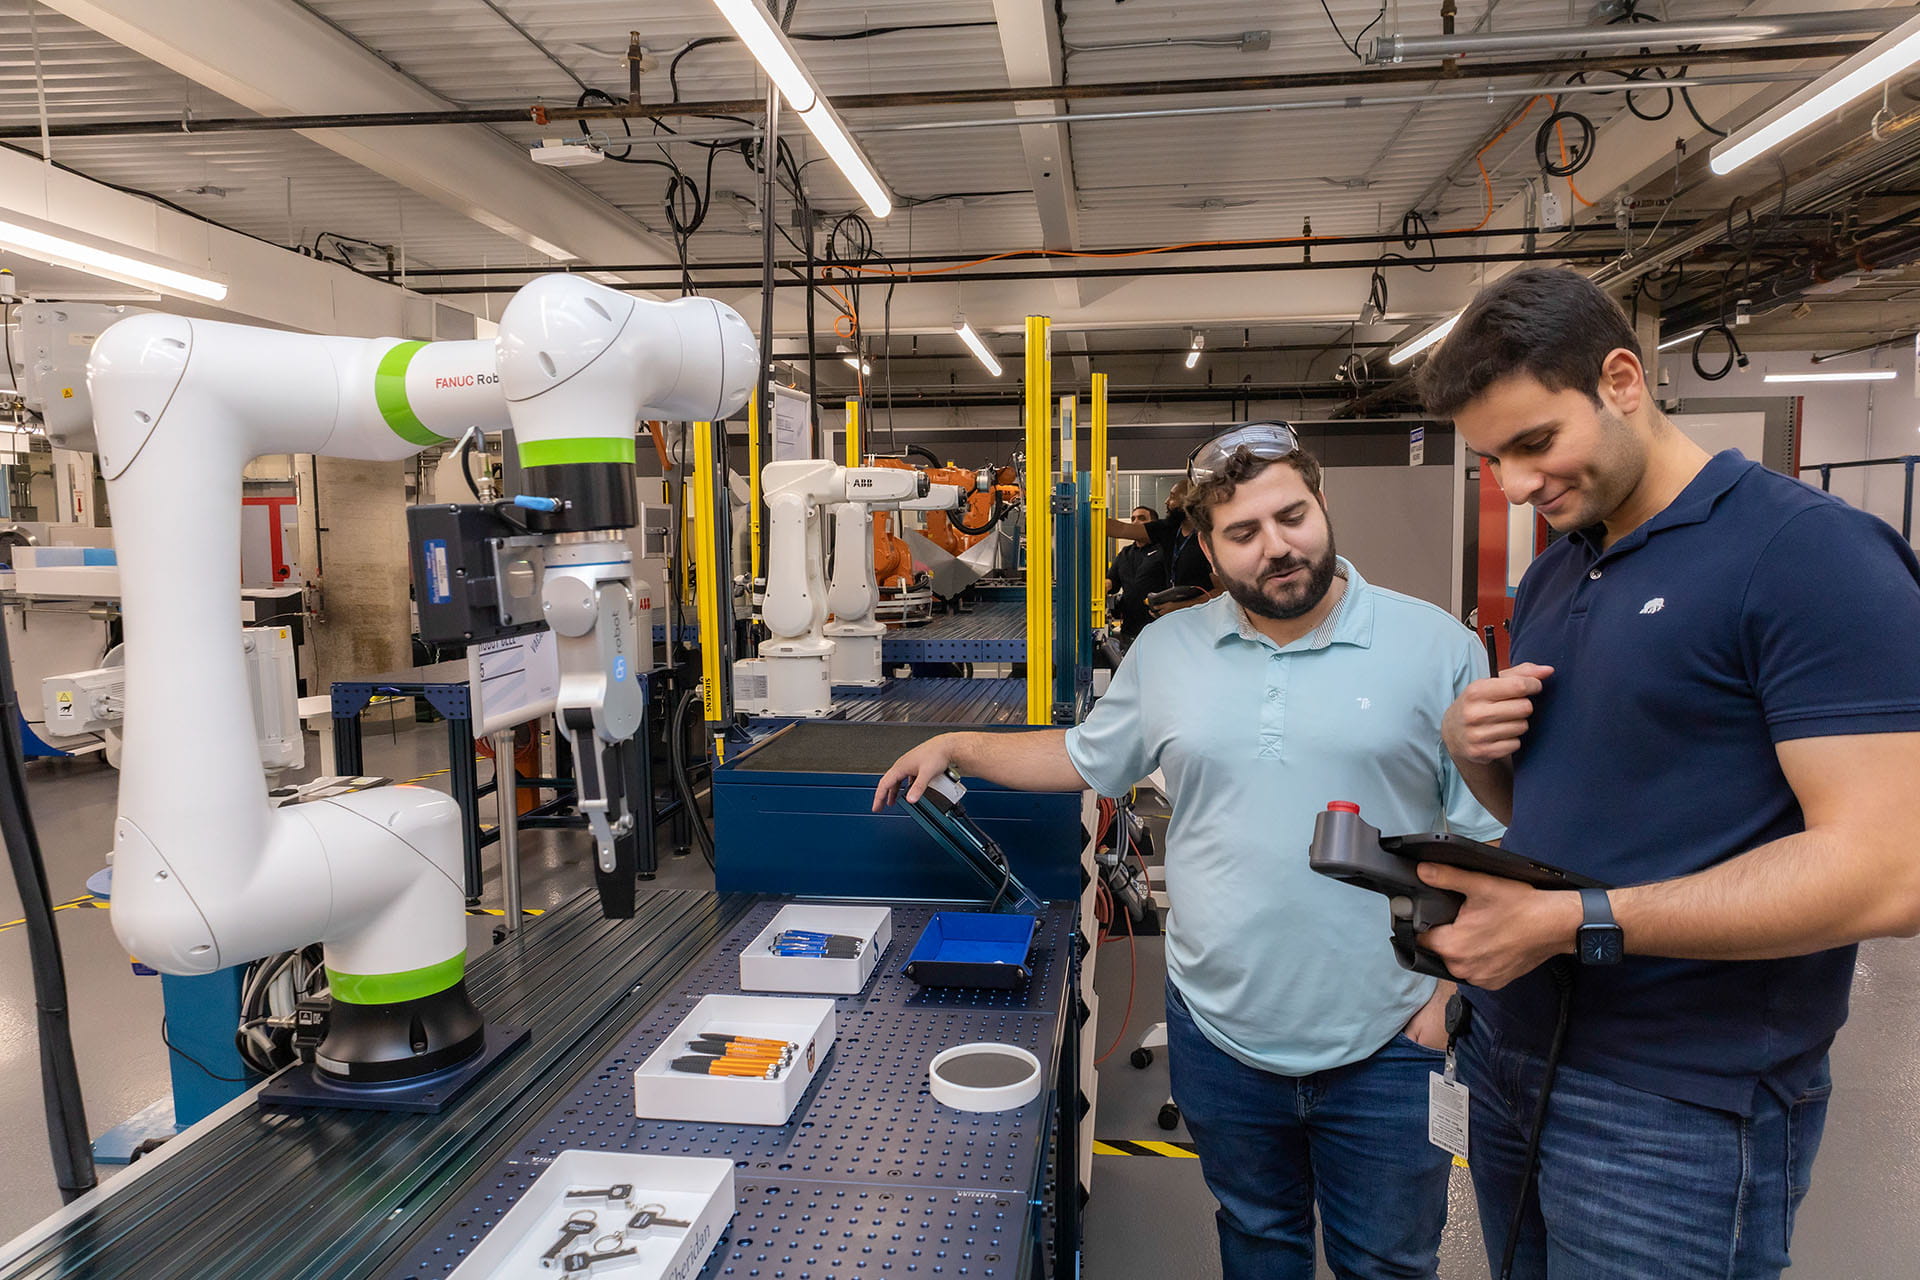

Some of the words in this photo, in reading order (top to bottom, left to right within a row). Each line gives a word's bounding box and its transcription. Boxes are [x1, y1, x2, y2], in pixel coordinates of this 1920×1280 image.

[435, 375, 474, 388] FANUC
[853, 478, 873, 488] ABB
[639, 597, 650, 610] ABB
[705, 677, 713, 713] SIEMENS
